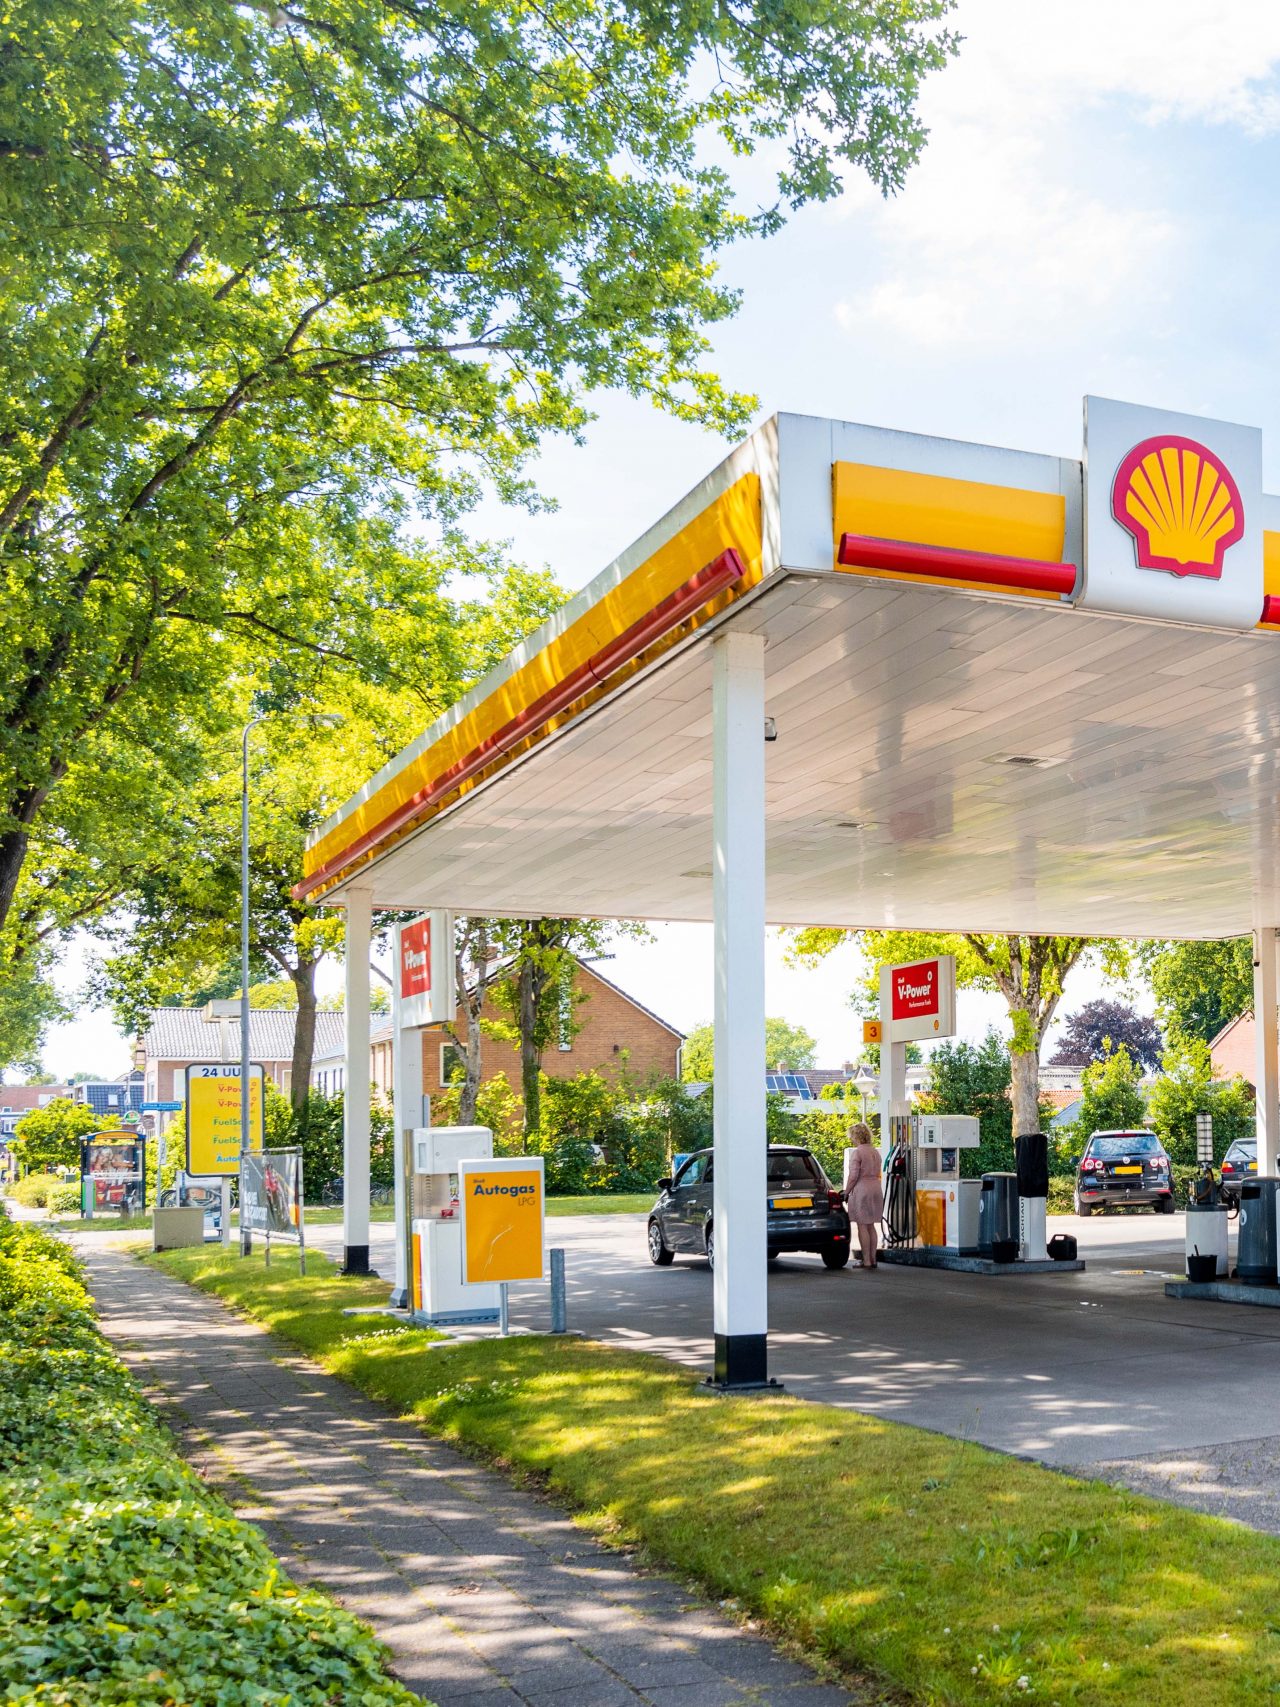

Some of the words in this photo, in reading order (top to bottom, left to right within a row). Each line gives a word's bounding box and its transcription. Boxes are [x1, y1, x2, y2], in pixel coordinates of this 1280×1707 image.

[897, 984, 932, 1000] V-Power
[870, 1026, 877, 1038] 3
[201, 1067, 218, 1078] 24
[222, 1067, 242, 1077] UU
[473, 1184, 536, 1197] Autogas
[518, 1197, 536, 1207] LPG
